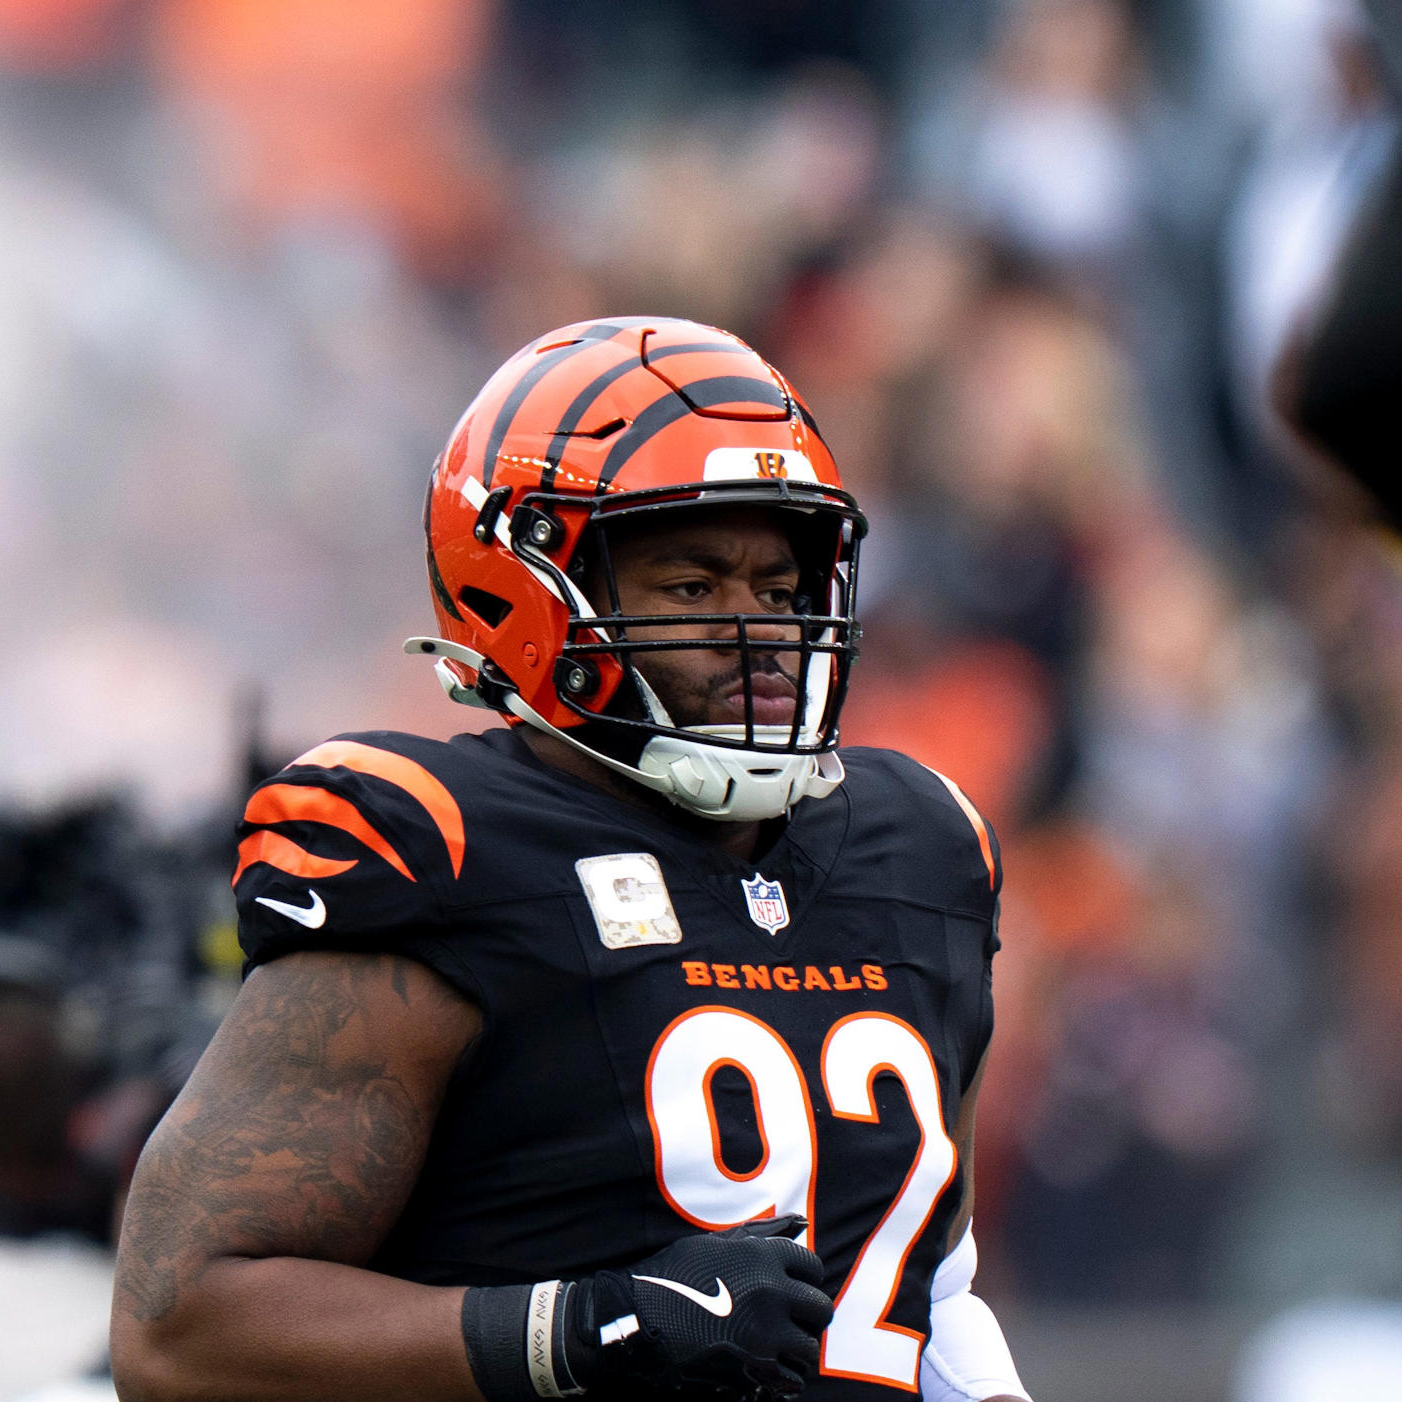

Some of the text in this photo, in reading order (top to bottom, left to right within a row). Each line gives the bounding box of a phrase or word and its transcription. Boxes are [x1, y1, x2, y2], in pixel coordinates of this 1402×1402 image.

[754, 900, 783, 924] NFL
[681, 961, 889, 991] BENGALS
[644, 1004, 957, 1393] 92
